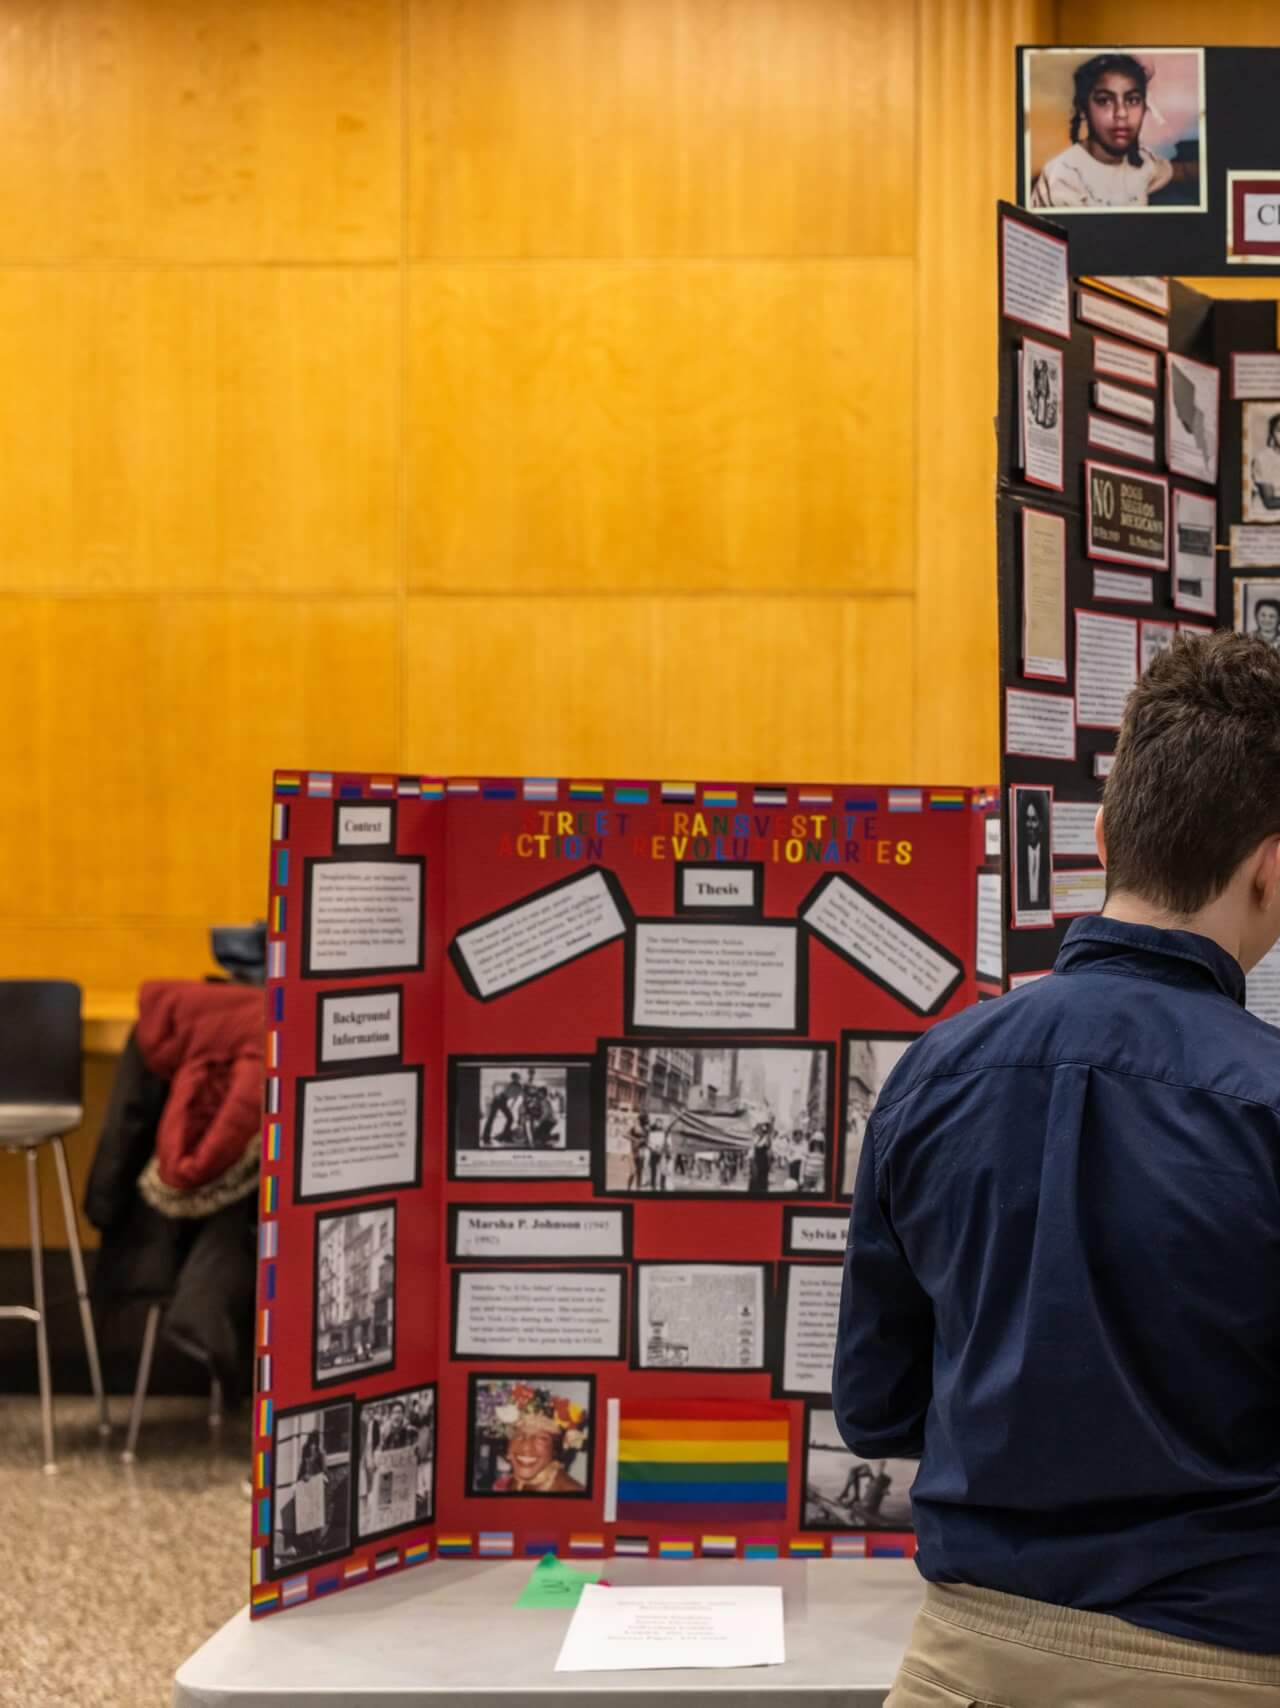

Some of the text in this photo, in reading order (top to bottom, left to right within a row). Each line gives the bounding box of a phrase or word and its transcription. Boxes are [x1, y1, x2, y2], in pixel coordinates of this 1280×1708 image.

[1093, 478, 1115, 521] NO
[344, 820, 382, 834] Context
[522, 810, 878, 840] STREET TRANSVESTITE
[497, 833, 913, 865] ACTION REVOLUTIONARIES
[696, 883, 740, 895] Thesis
[333, 1008, 391, 1025] Background
[332, 1032, 390, 1046] Information
[469, 1218, 514, 1229] Marsha
[532, 1218, 581, 1229] Johnson
[801, 1228, 837, 1241] Sylvia
